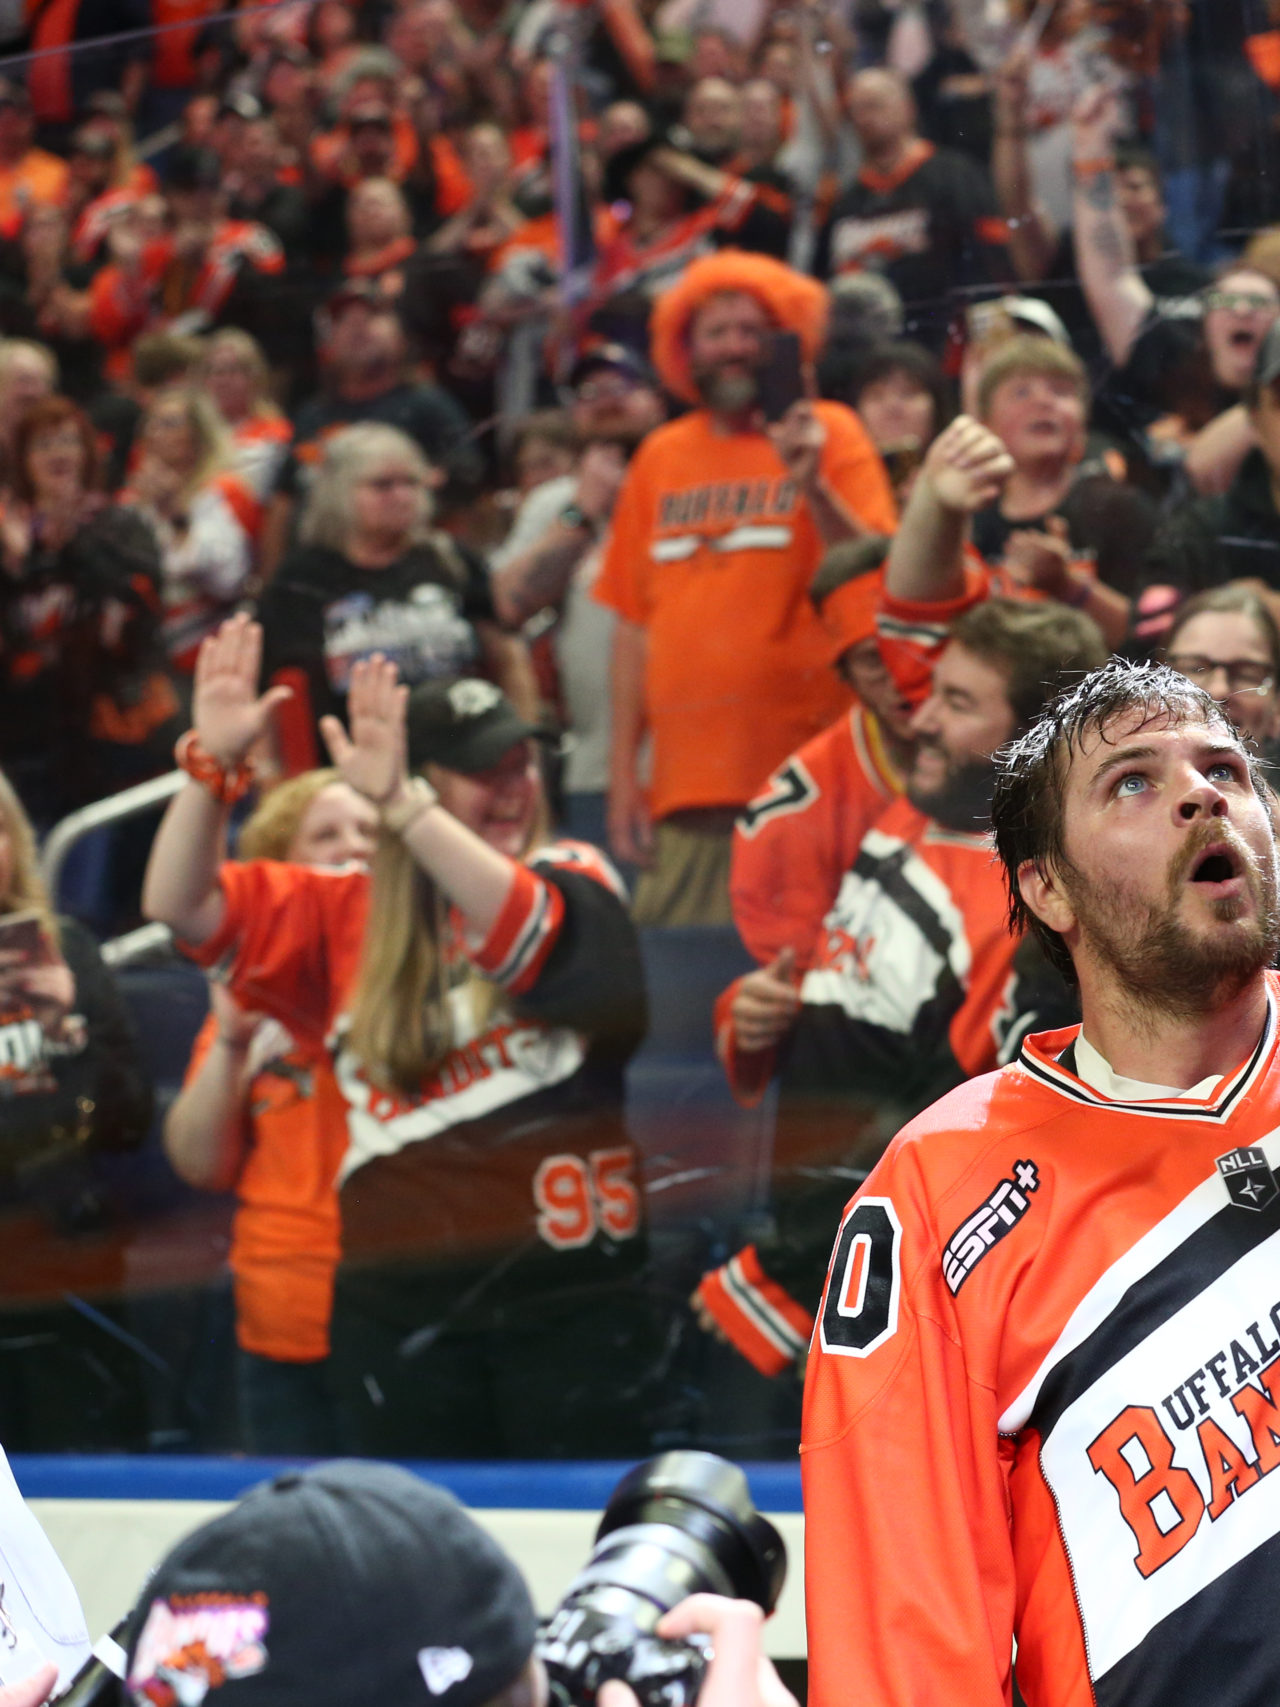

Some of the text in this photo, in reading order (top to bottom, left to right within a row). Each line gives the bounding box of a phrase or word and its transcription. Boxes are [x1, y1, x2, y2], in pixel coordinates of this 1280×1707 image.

[533, 1147, 640, 1249] 95
[1220, 1151, 1264, 1173] NLL
[809, 1196, 903, 1359] 0
